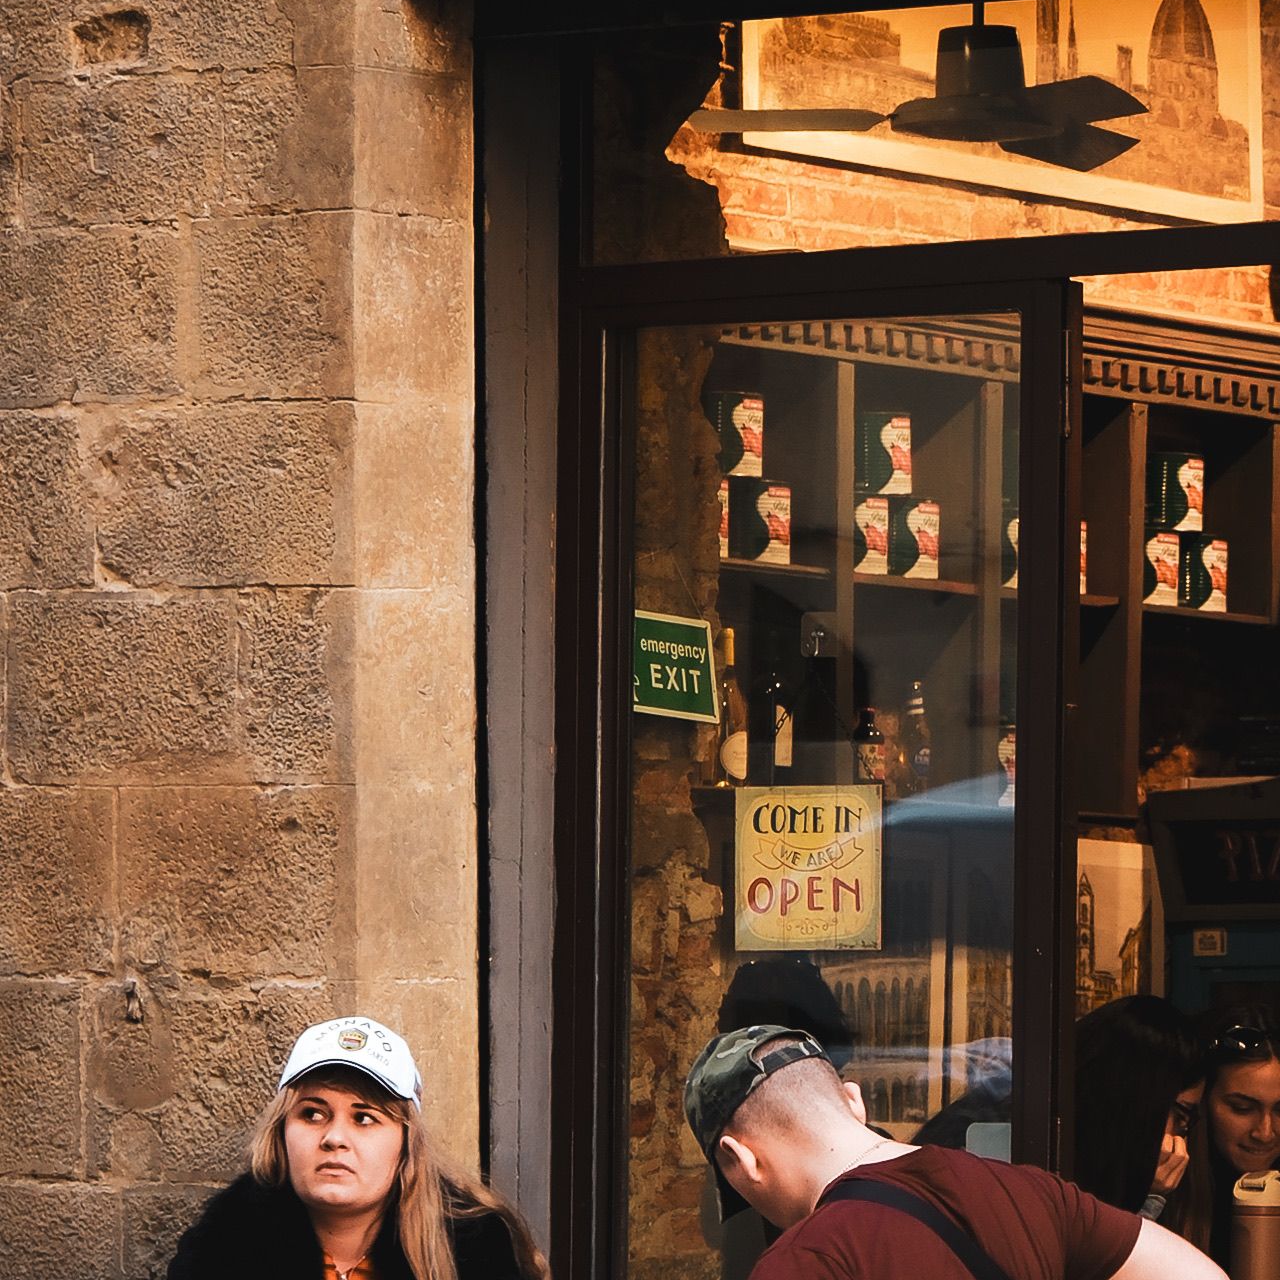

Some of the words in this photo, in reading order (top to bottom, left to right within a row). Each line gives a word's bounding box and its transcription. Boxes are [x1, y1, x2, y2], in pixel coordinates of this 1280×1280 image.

[640, 638, 706, 664] emergency
[650, 663, 701, 694] EXIT
[753, 802, 825, 835] COME
[834, 805, 863, 834] IN
[780, 845, 801, 867] WE
[806, 846, 836, 868] ARE
[747, 876, 862, 917] OPEN
[315, 1019, 393, 1053] MONACO
